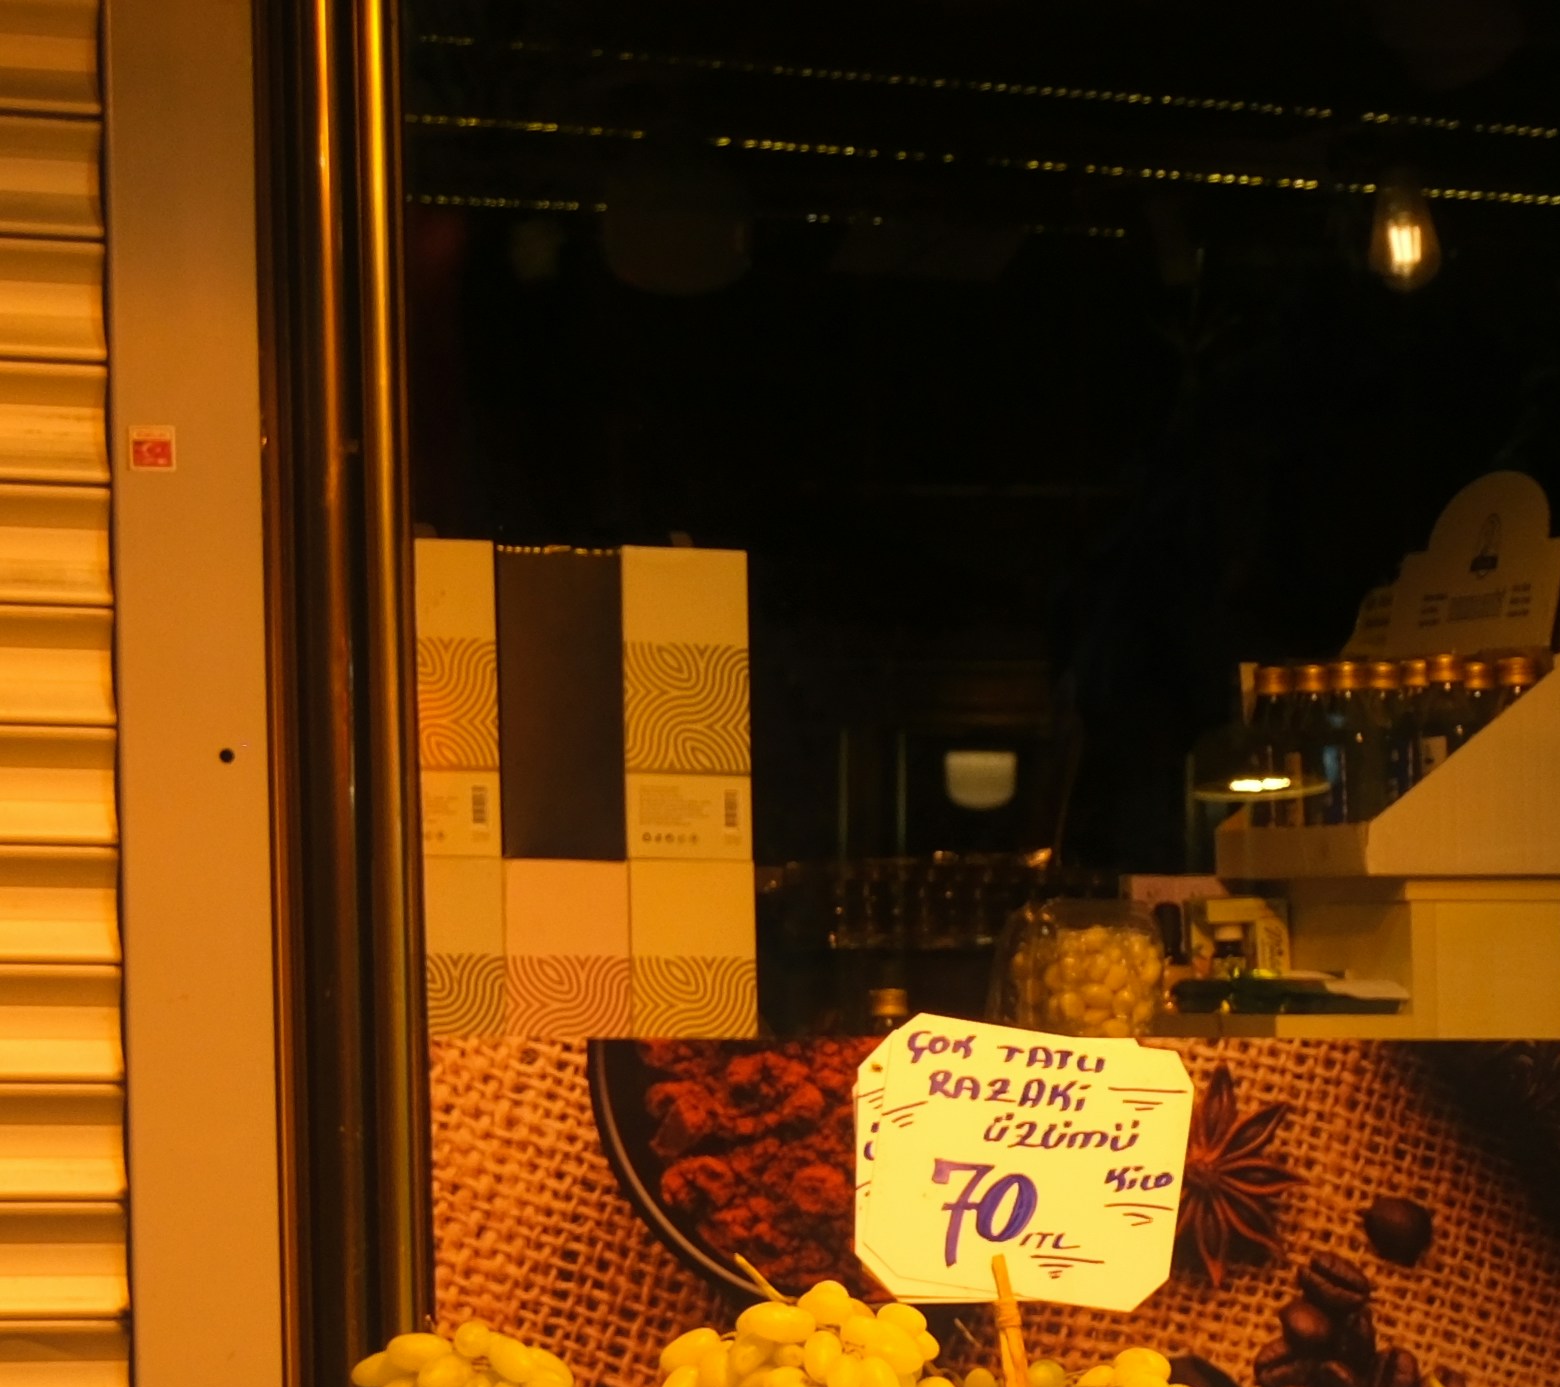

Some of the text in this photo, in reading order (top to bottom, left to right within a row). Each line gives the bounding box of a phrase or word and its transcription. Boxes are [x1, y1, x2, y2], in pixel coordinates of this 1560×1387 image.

[907, 1031, 976, 1063] ÇOK
[928, 1071, 1092, 1112] RAZAKİ
[983, 1113, 1140, 1151] ÜZÜMÜ
[931, 1158, 1038, 1267] 70
